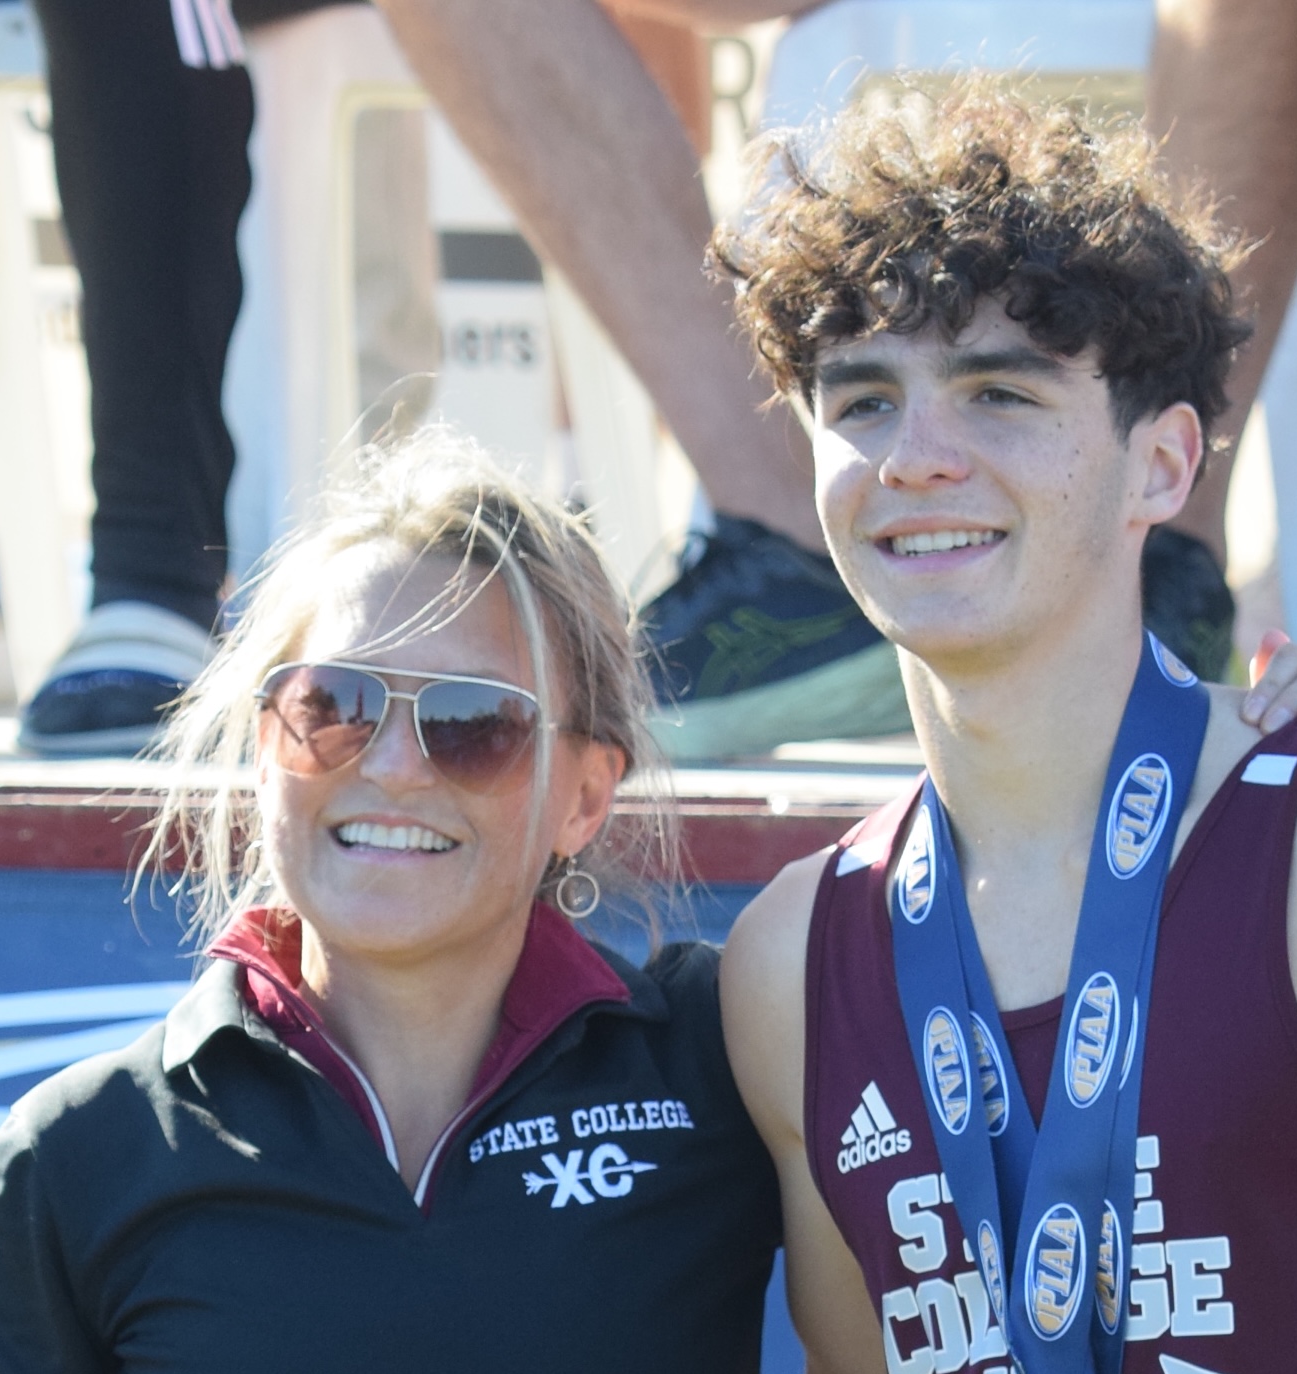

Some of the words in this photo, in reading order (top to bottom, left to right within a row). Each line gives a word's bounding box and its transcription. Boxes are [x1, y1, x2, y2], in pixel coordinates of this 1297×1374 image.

[1114, 766, 1166, 860] PIAA
[929, 1027, 967, 1129] PIAA
[1071, 985, 1113, 1087] PIAA
[469, 1116, 559, 1163] STATE
[571, 1099, 695, 1138] COLLEGE
[541, 1142, 635, 1208] XC
[837, 1127, 912, 1174] adidas
[1035, 1218, 1078, 1321] PIAA
